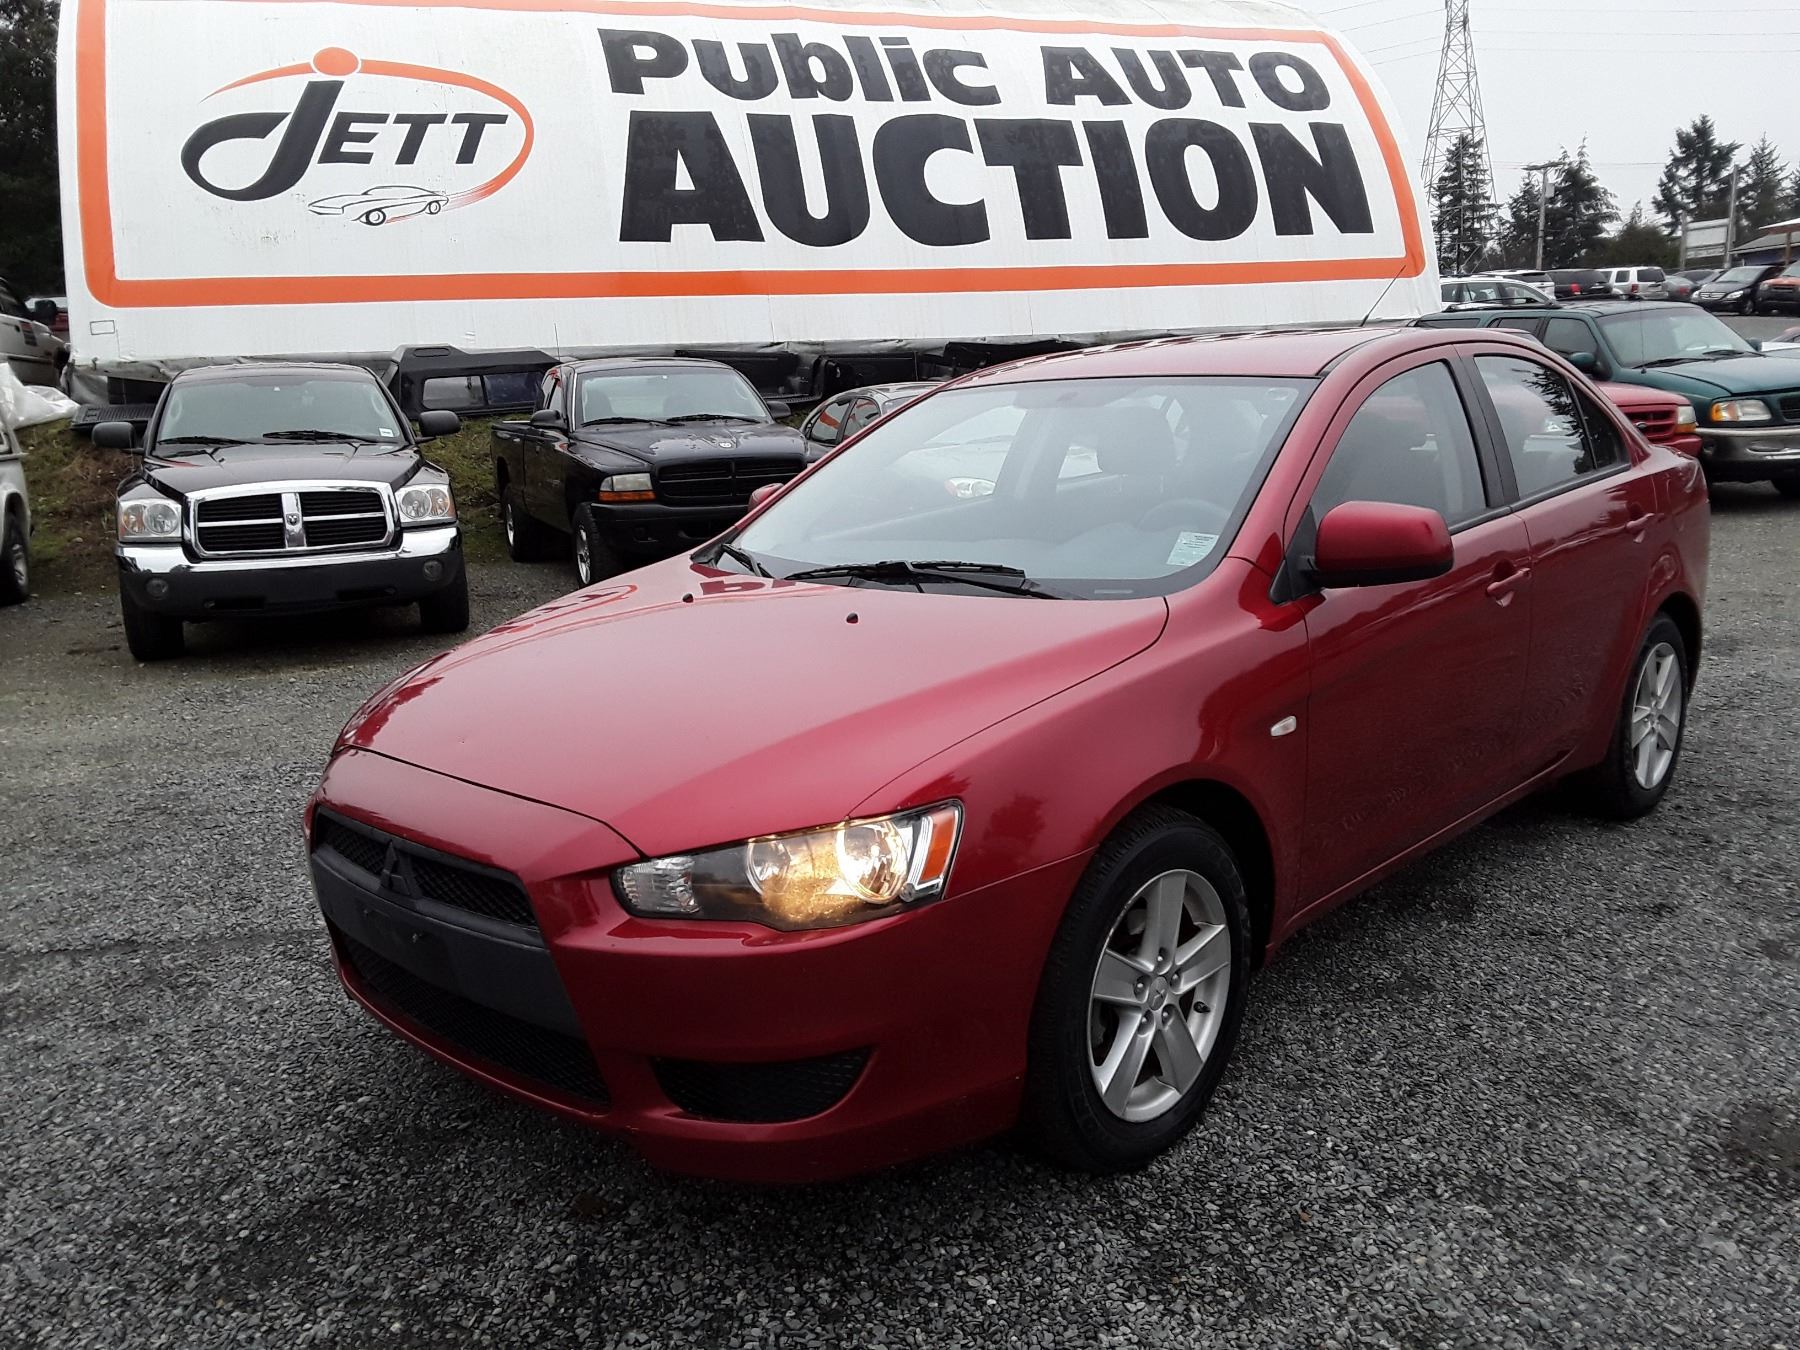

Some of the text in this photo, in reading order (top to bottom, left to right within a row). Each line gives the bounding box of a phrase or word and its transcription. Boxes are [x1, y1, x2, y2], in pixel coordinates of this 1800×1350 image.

[181, 79, 509, 202] JETT
[1041, 46, 1331, 112] AUTO
[619, 110, 1374, 248] AUCTION
